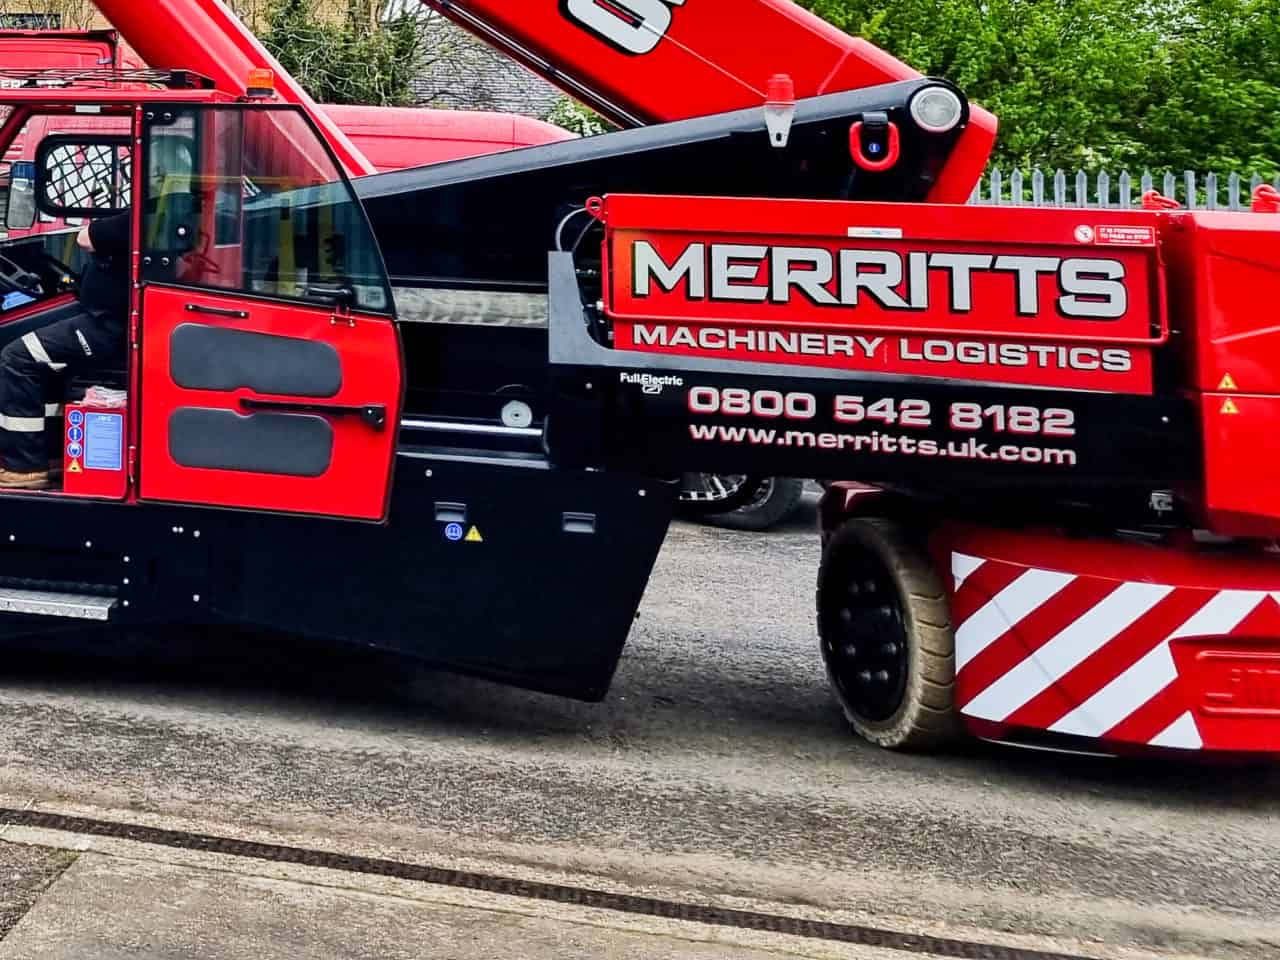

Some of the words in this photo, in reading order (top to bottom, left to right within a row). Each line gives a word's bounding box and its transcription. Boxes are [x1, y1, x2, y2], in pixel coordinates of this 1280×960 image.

[634, 240, 1127, 318] MERRITTS
[634, 324, 884, 357] MACHINERY
[900, 338, 1132, 371] LOGISTICS
[689, 386, 816, 418] 0800
[834, 395, 932, 426] 542
[951, 402, 1076, 436] 8182
[690, 424, 1077, 466] www.merritts.uk.com
